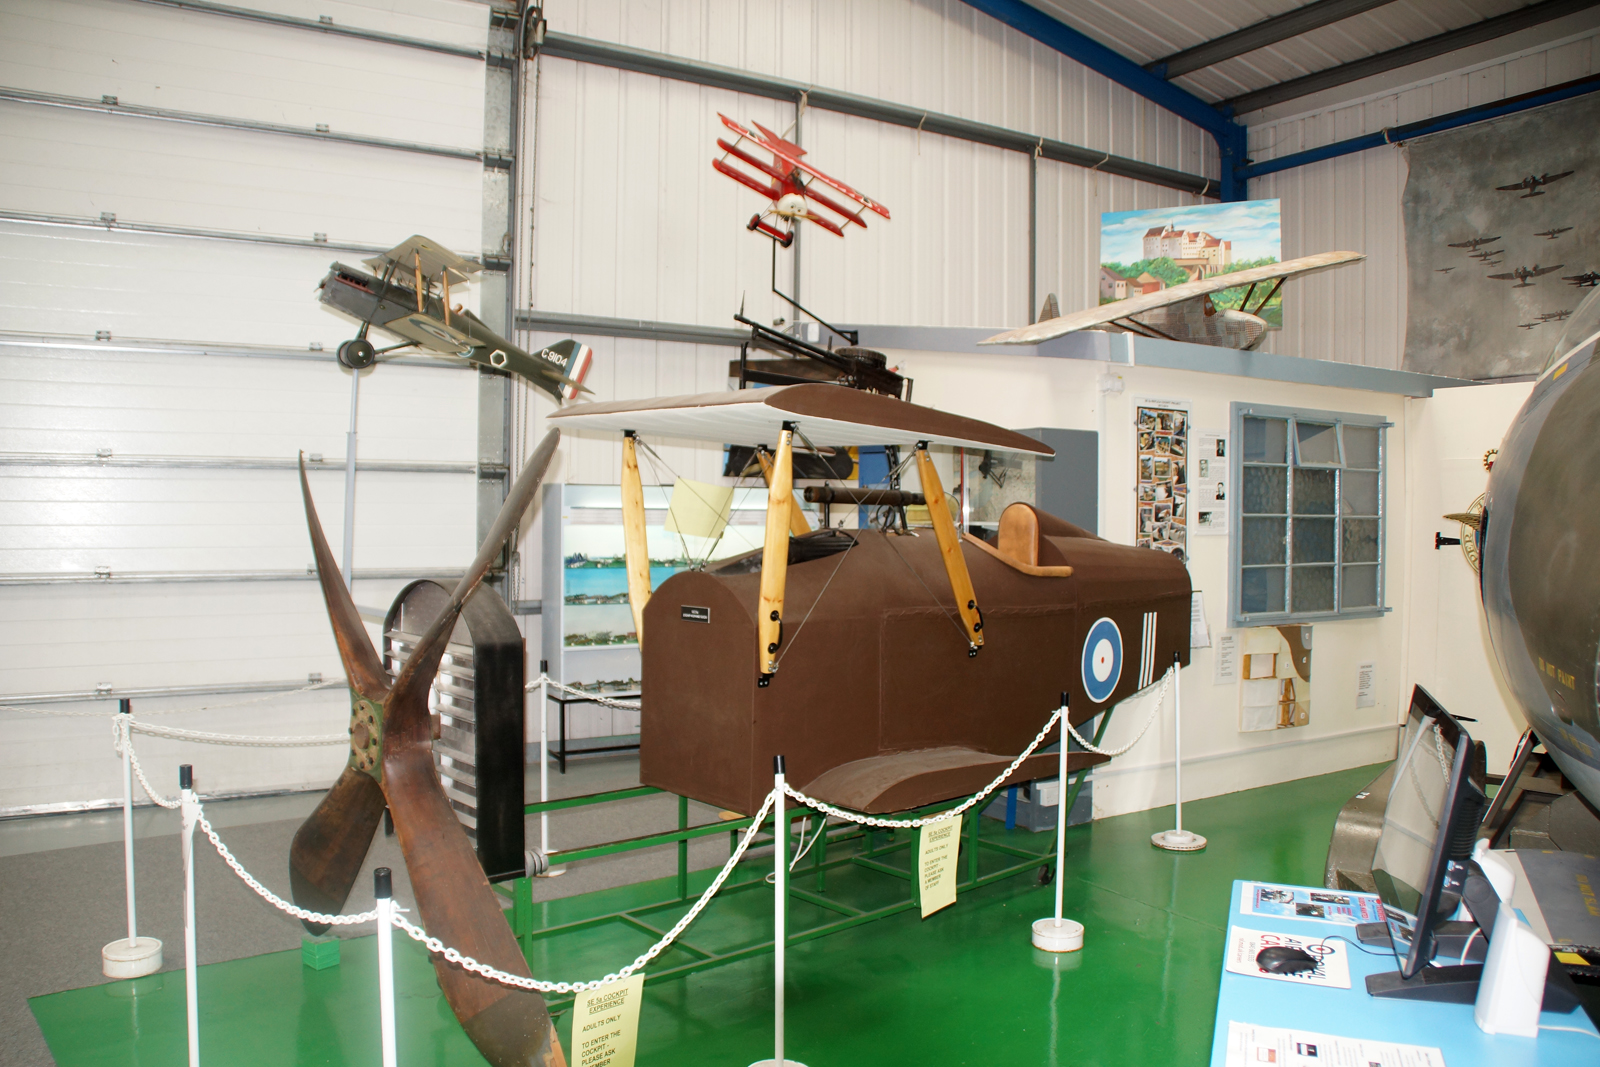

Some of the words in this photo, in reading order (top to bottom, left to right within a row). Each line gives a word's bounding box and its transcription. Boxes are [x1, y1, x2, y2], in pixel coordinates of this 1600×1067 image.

[541, 348, 568, 368] C9104
[939, 843, 949, 851] ONLY
[930, 857, 941, 866] ENTER
[924, 863, 939, 873] COCKPIT
[924, 870, 937, 878] PLEASE
[927, 873, 941, 883] MEMBER
[929, 880, 940, 888] STAFF
[587, 998, 596, 1007] SE
[603, 988, 629, 1002] COCKPIT
[589, 997, 625, 1014] EXPERIENCE
[582, 1019, 605, 1032] ADULTS
[605, 1014, 621, 1025] ONLY
[581, 1041, 590, 1049] TO
[590, 1034, 609, 1046] ENTER
[610, 1029, 621, 1039] THE
[581, 1043, 606, 1058] COCKPIT
[581, 1052, 603, 1067] PLEASE
[604, 1047, 616, 1058] ASK
[589, 1058, 611, 1067] EMBER
